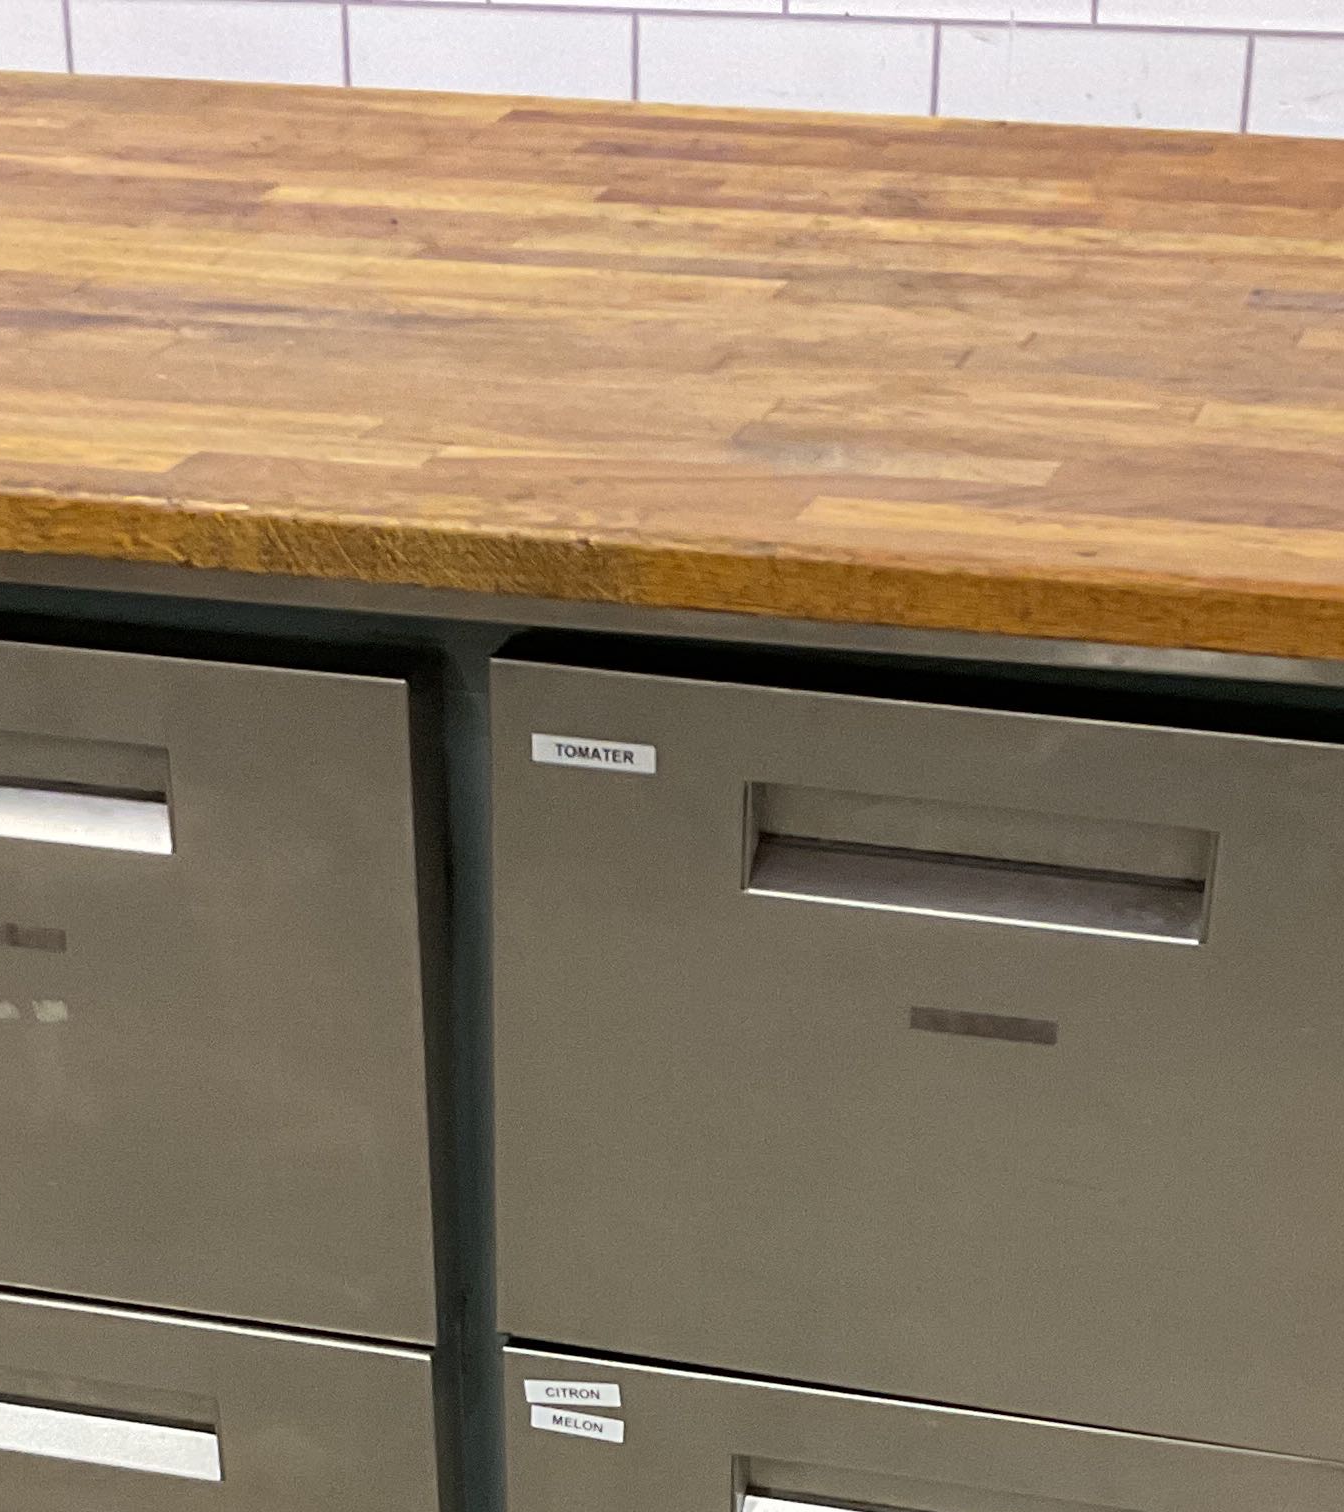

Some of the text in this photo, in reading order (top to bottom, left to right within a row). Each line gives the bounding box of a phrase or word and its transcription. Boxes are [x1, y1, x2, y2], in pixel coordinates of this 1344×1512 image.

[555, 742, 635, 764] TOMATER
[545, 1386, 601, 1400] CITRON
[552, 1414, 603, 1432] MELON
